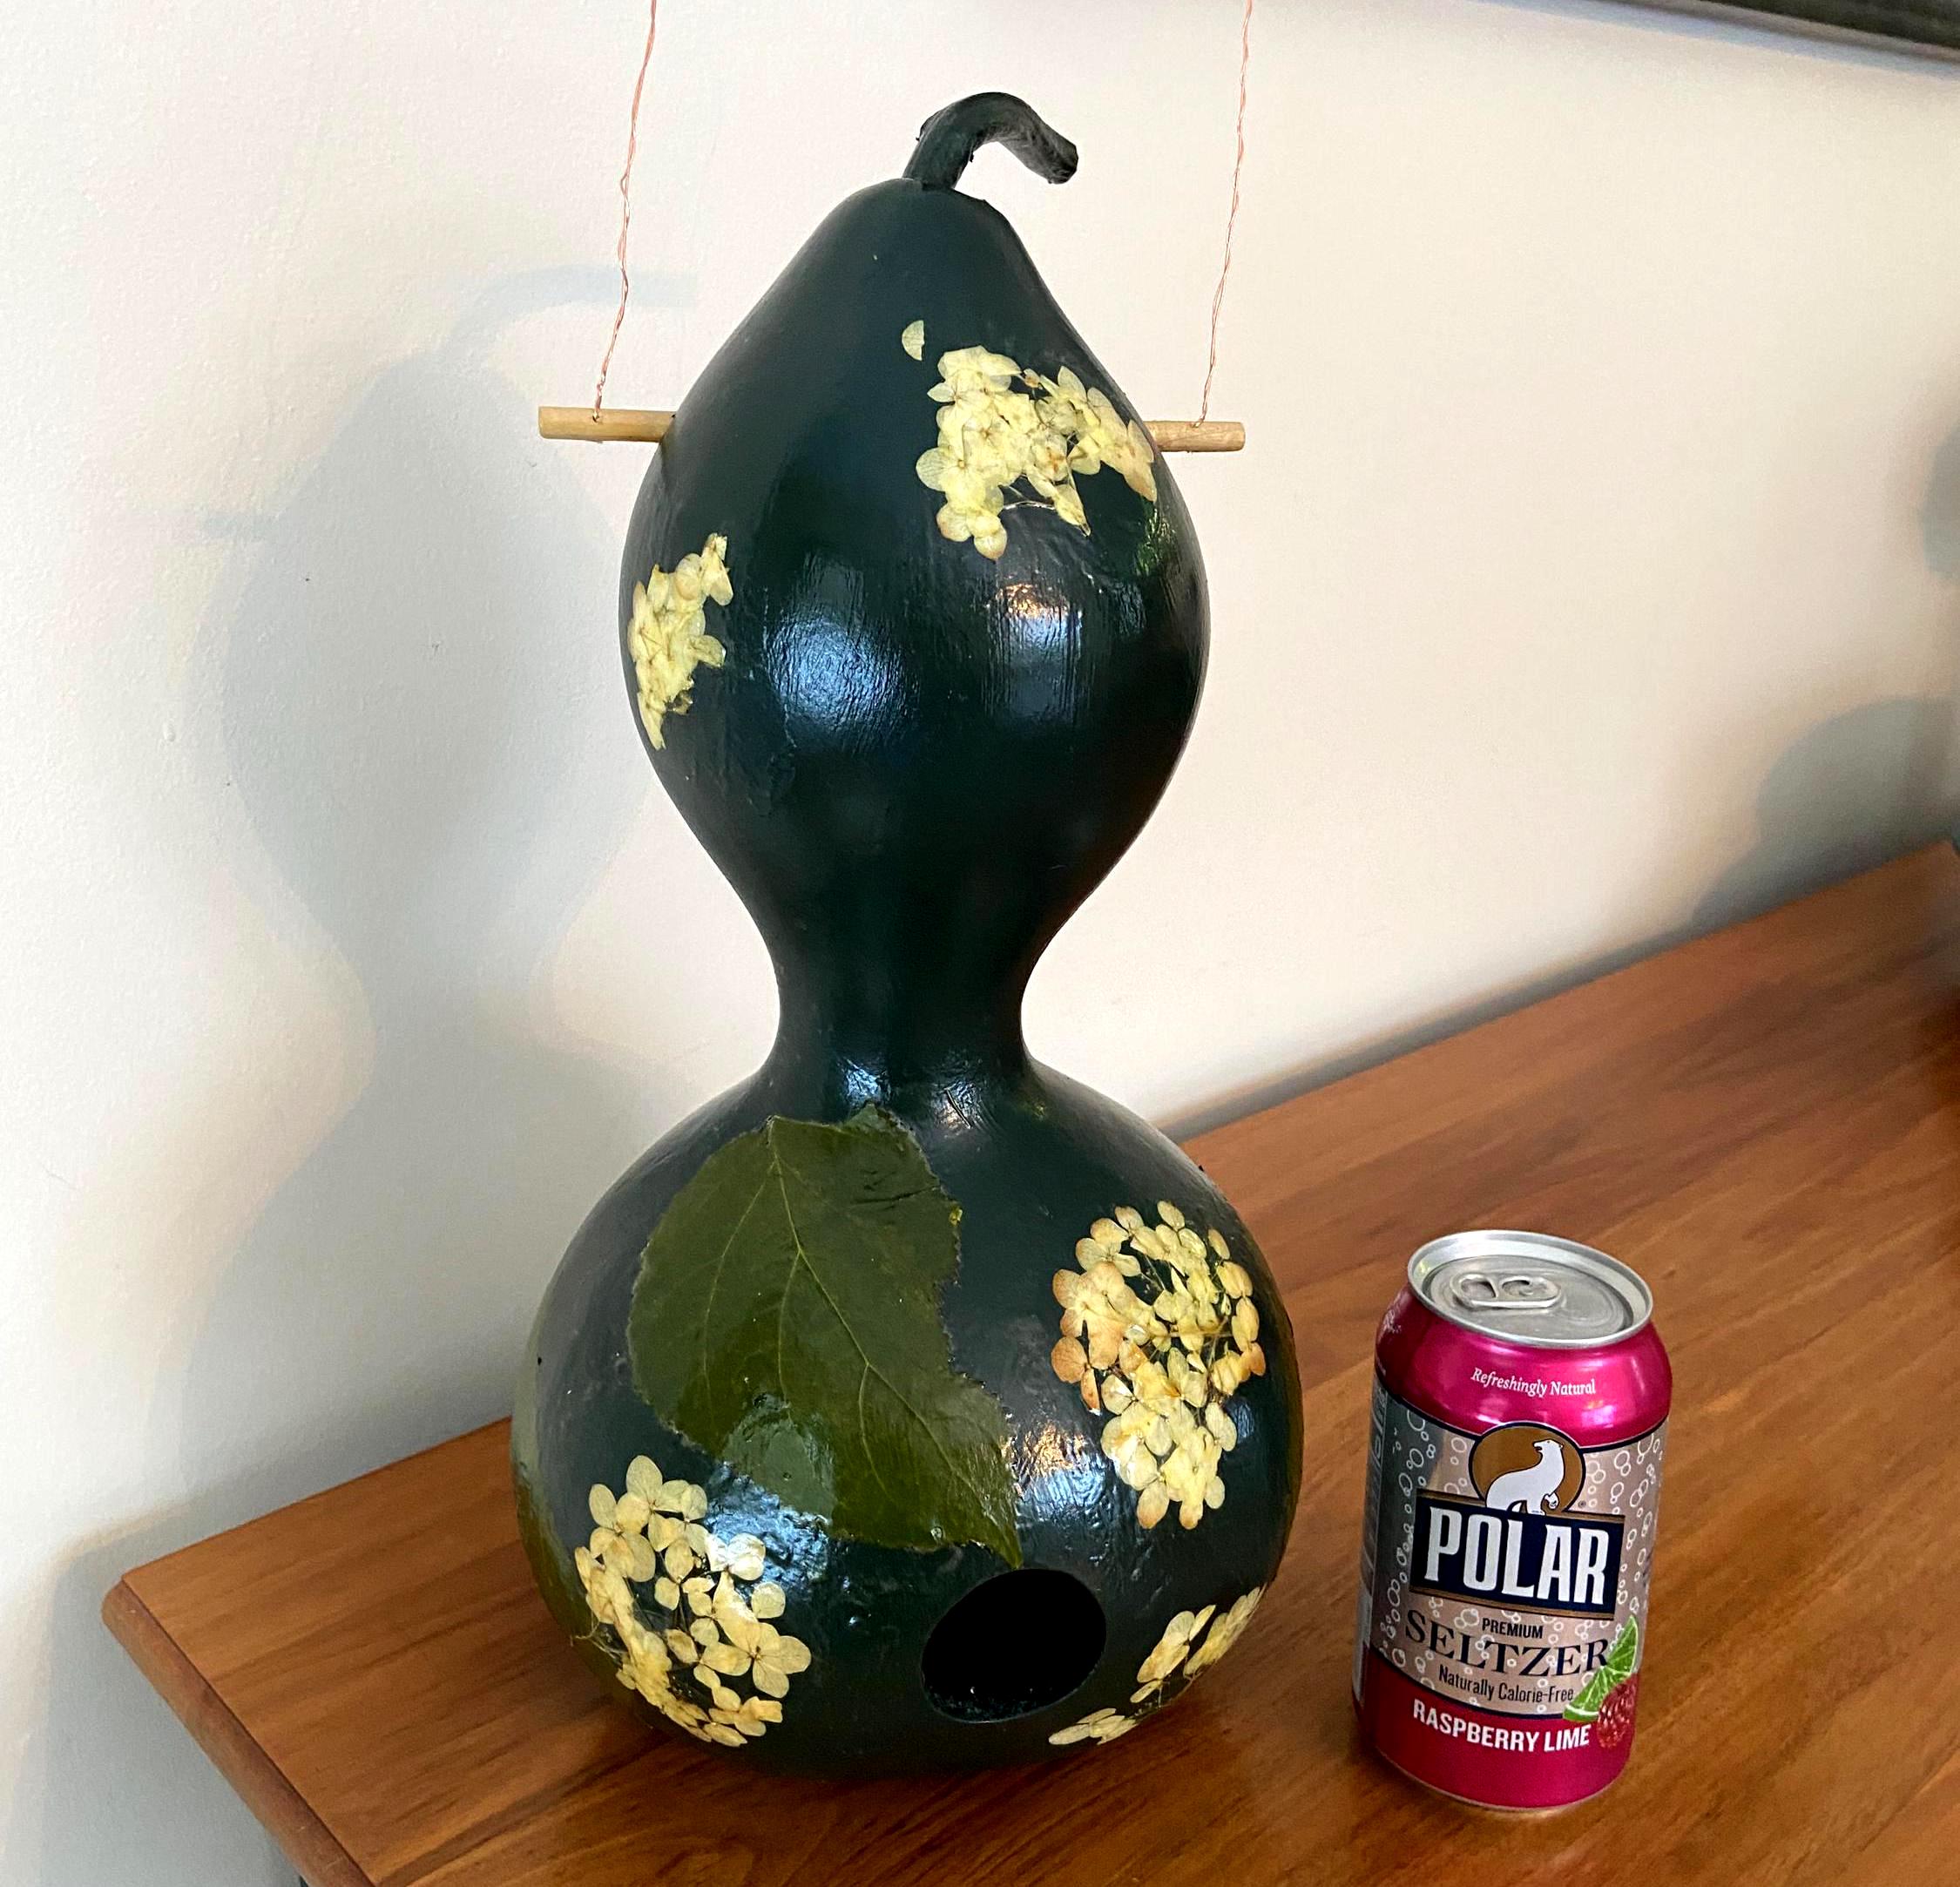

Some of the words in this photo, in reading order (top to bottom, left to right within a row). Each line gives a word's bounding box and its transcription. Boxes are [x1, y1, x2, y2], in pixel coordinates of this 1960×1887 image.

[1470, 1367, 1547, 1397] Refreshingly
[1550, 1378, 1596, 1396] Natural
[1424, 1506, 1610, 1605] POLAR
[1405, 1610, 1610, 1676] SELTZER
[1482, 1618, 1543, 1639] PREMIUM
[1439, 1664, 1494, 1698] Naturally
[1498, 1683, 1574, 1703] Calorie-Free
[1413, 1699, 1539, 1752] RASPBERRY
[1544, 1724, 1592, 1752] LIME
